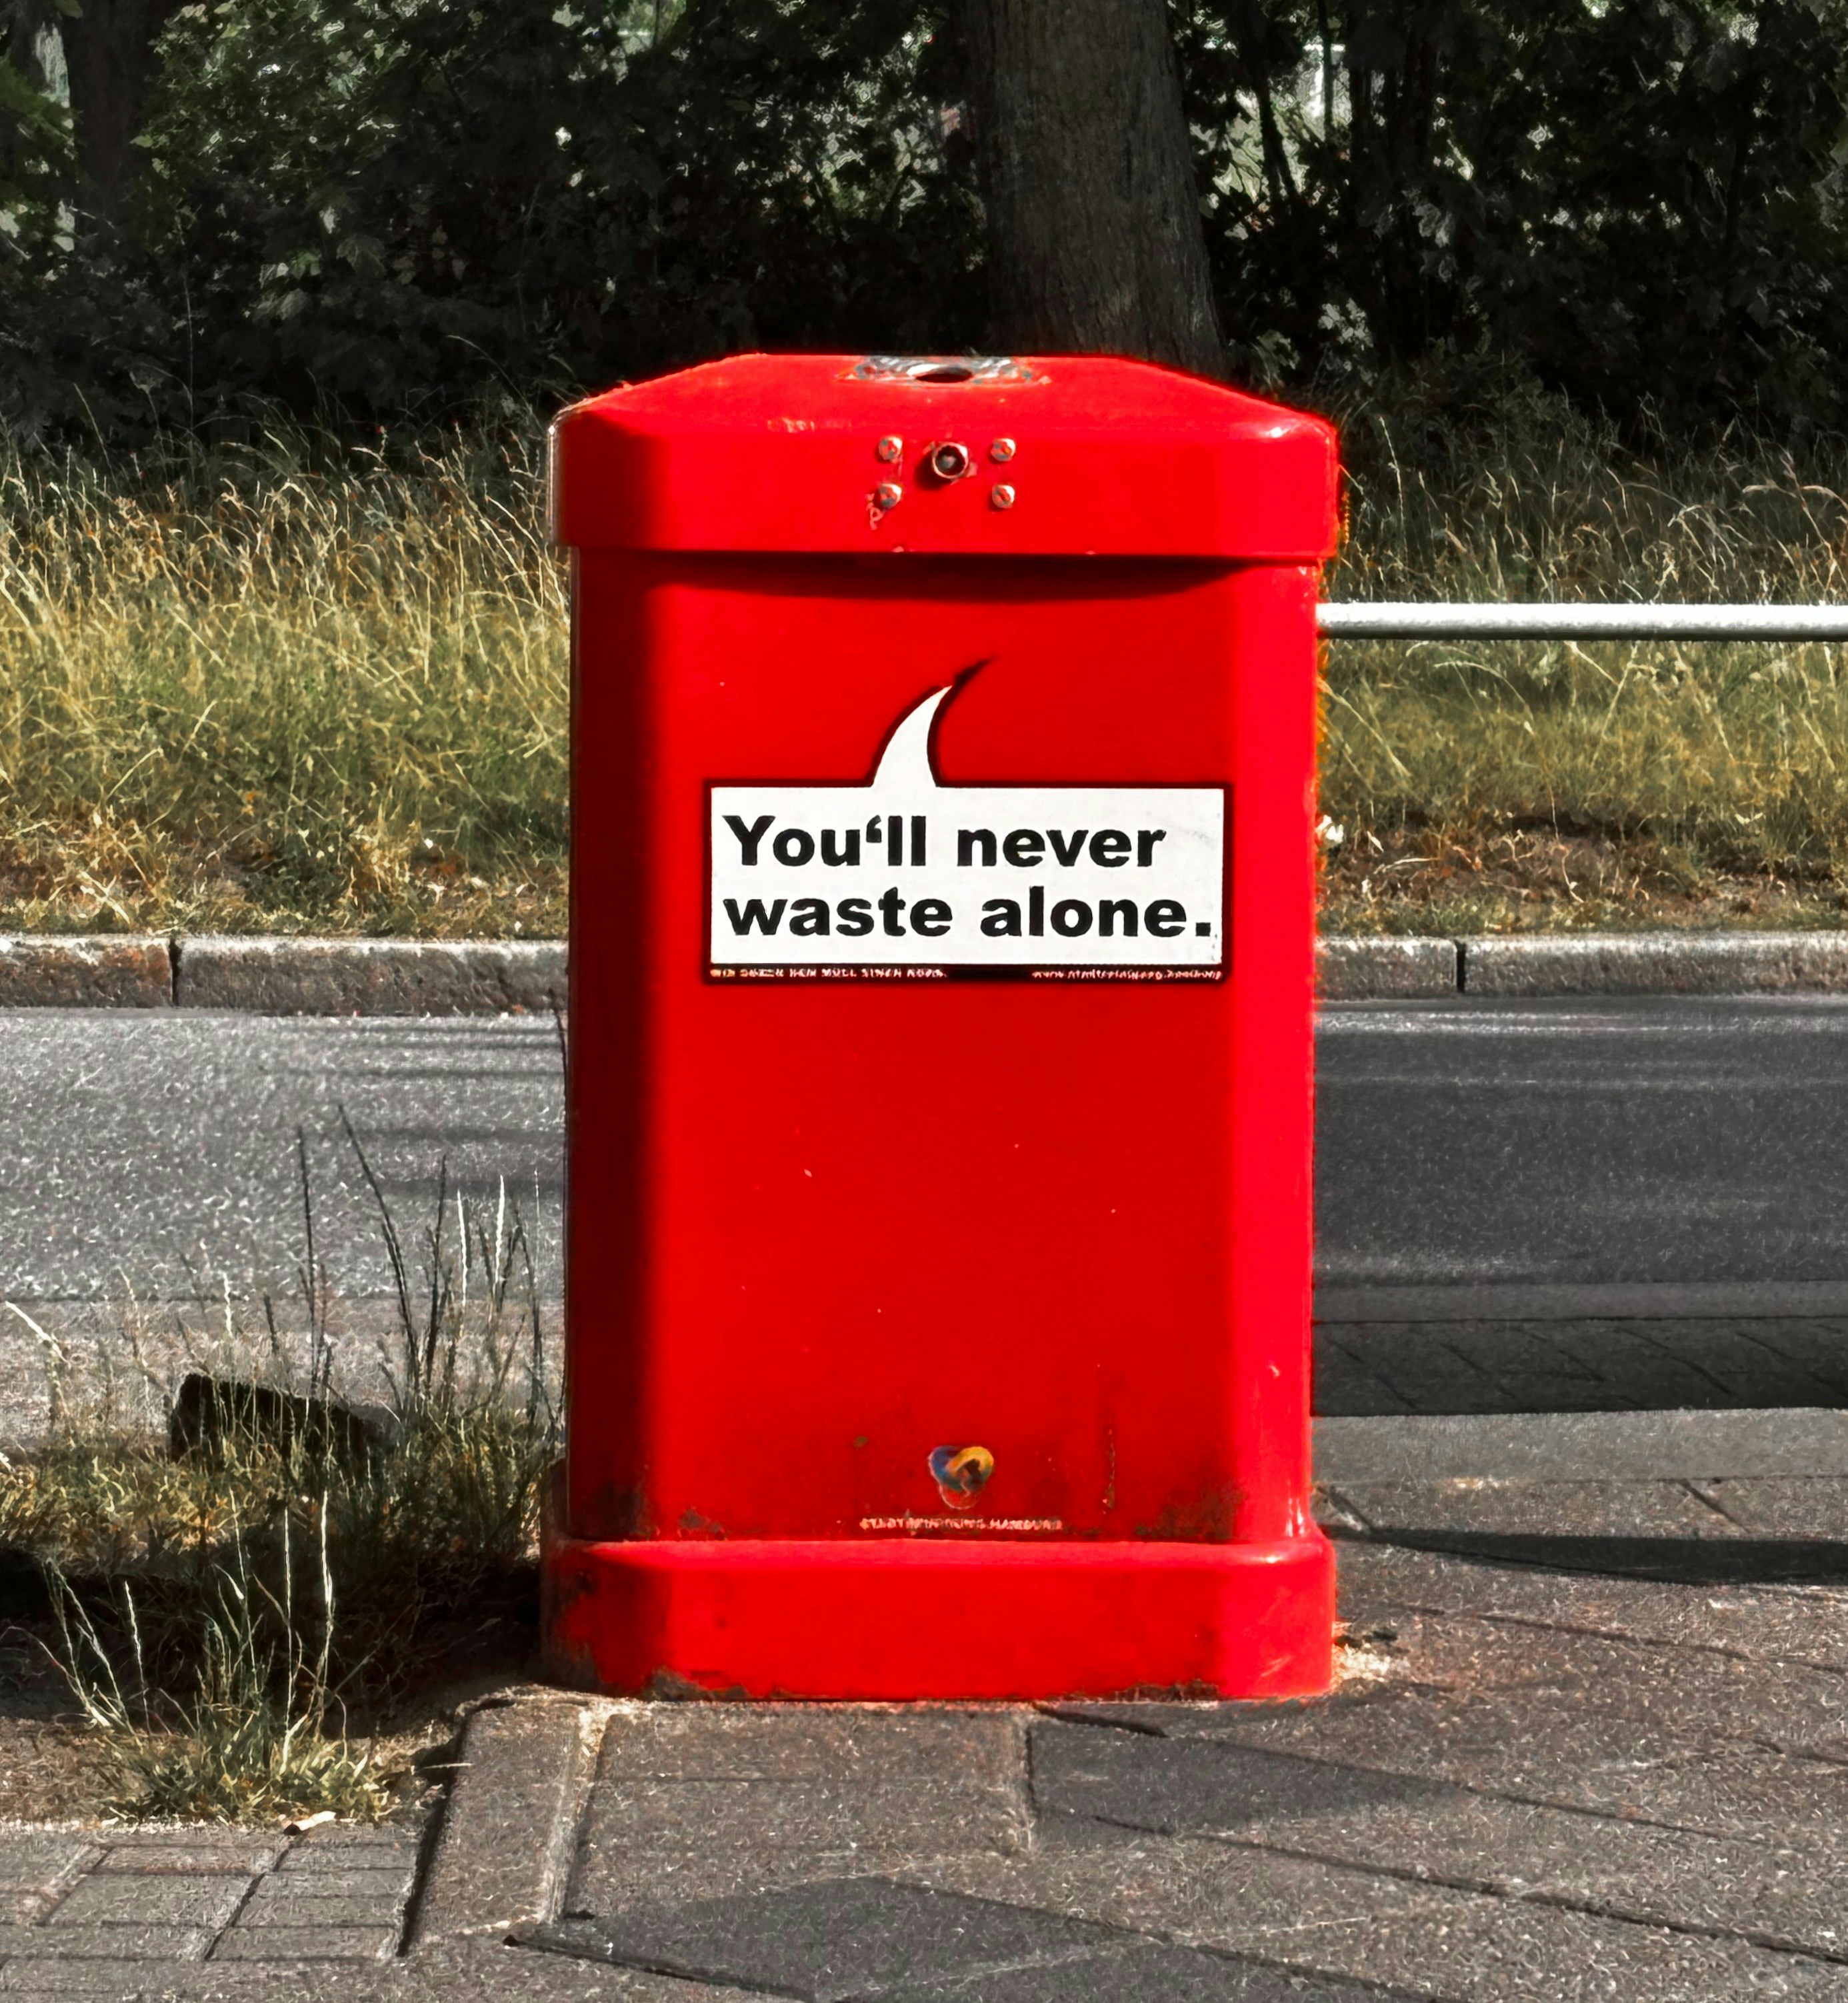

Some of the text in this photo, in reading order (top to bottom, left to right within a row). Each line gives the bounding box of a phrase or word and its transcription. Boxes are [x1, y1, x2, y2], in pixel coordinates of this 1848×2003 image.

[957, 829, 1167, 868] never
[723, 886, 1211, 938] waste alone.
